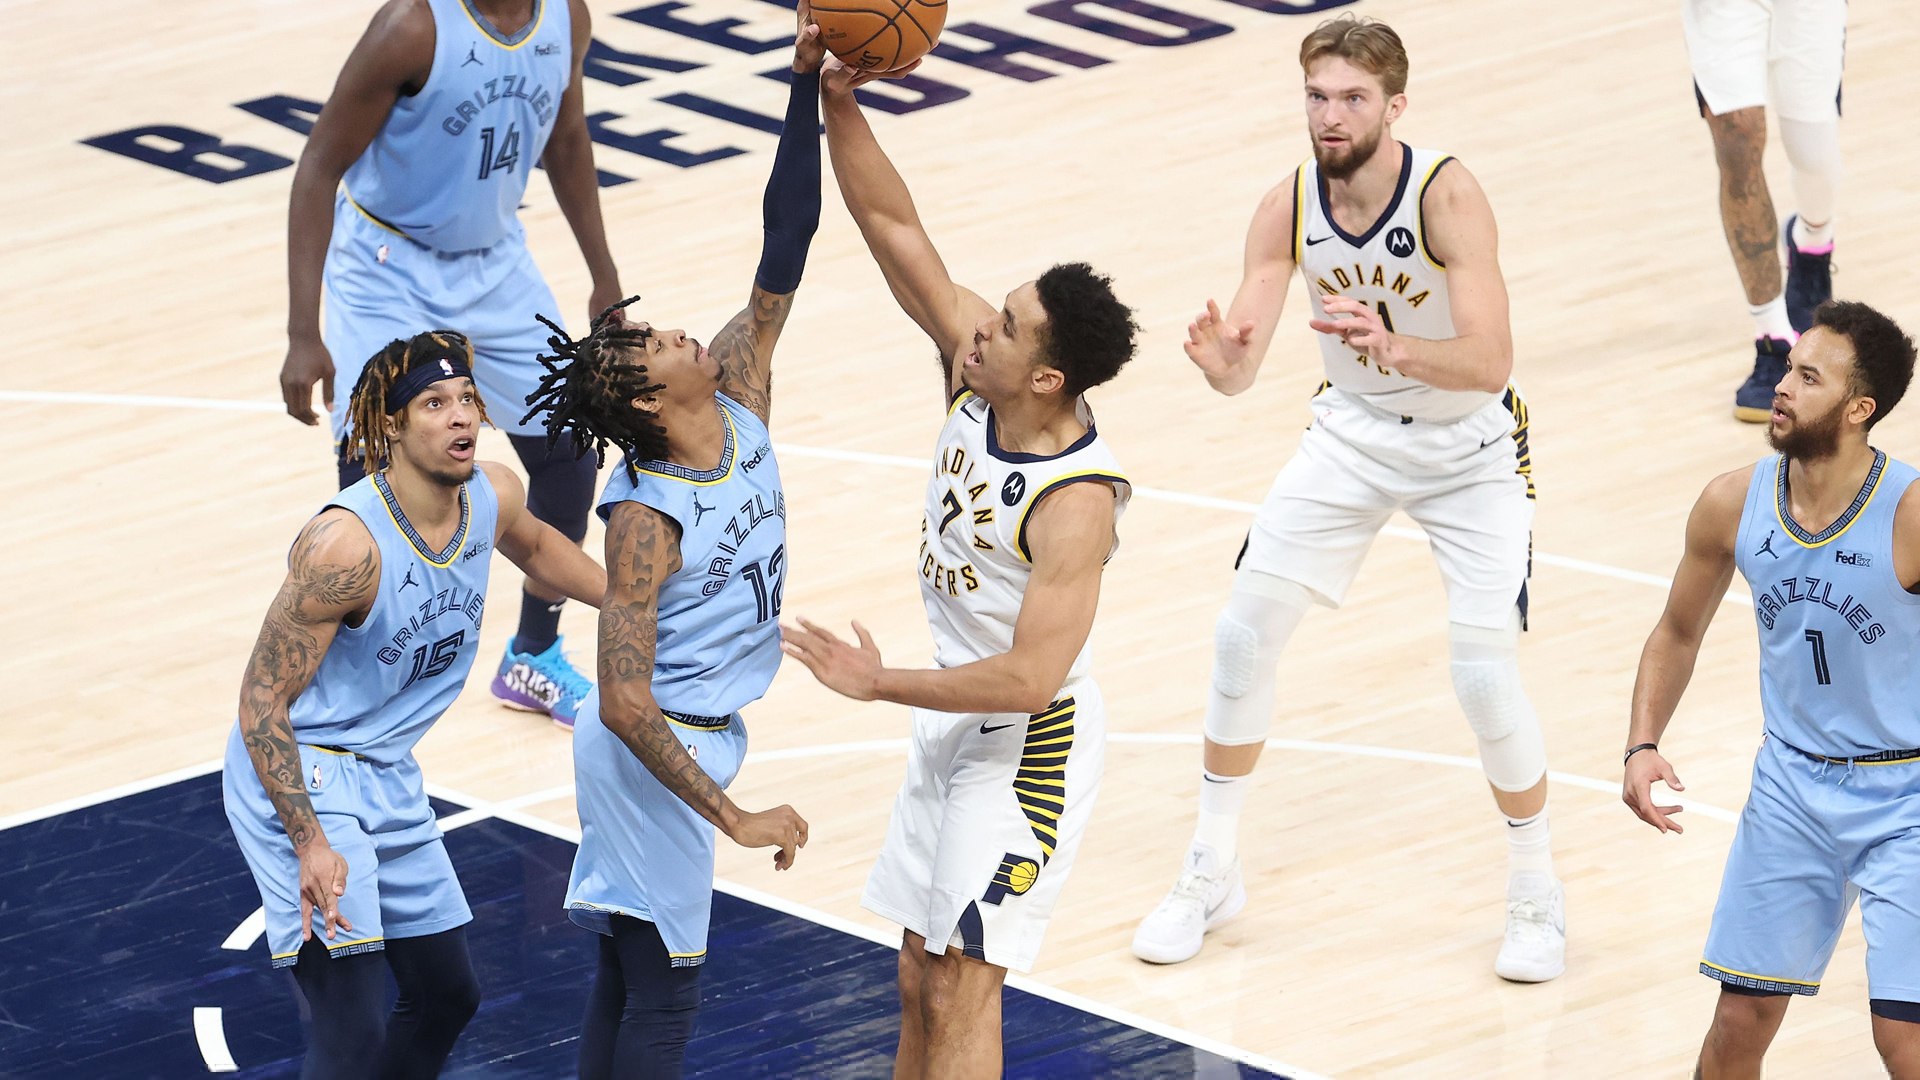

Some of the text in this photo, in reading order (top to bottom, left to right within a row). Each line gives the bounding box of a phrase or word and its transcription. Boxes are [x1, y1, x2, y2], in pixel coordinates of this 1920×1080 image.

[442, 74, 553, 136] GRIZZLIES
[477, 121, 520, 180] 14
[740, 443, 770, 473] FedEx
[938, 488, 964, 537] 7
[463, 540, 488, 563] FedEx
[702, 490, 786, 597] GRIZZLIE
[1835, 550, 1871, 567] FedEx
[1757, 576, 1886, 644] GRIZZLIES
[401, 629, 465, 691] 15
[1804, 629, 1831, 685] 1
